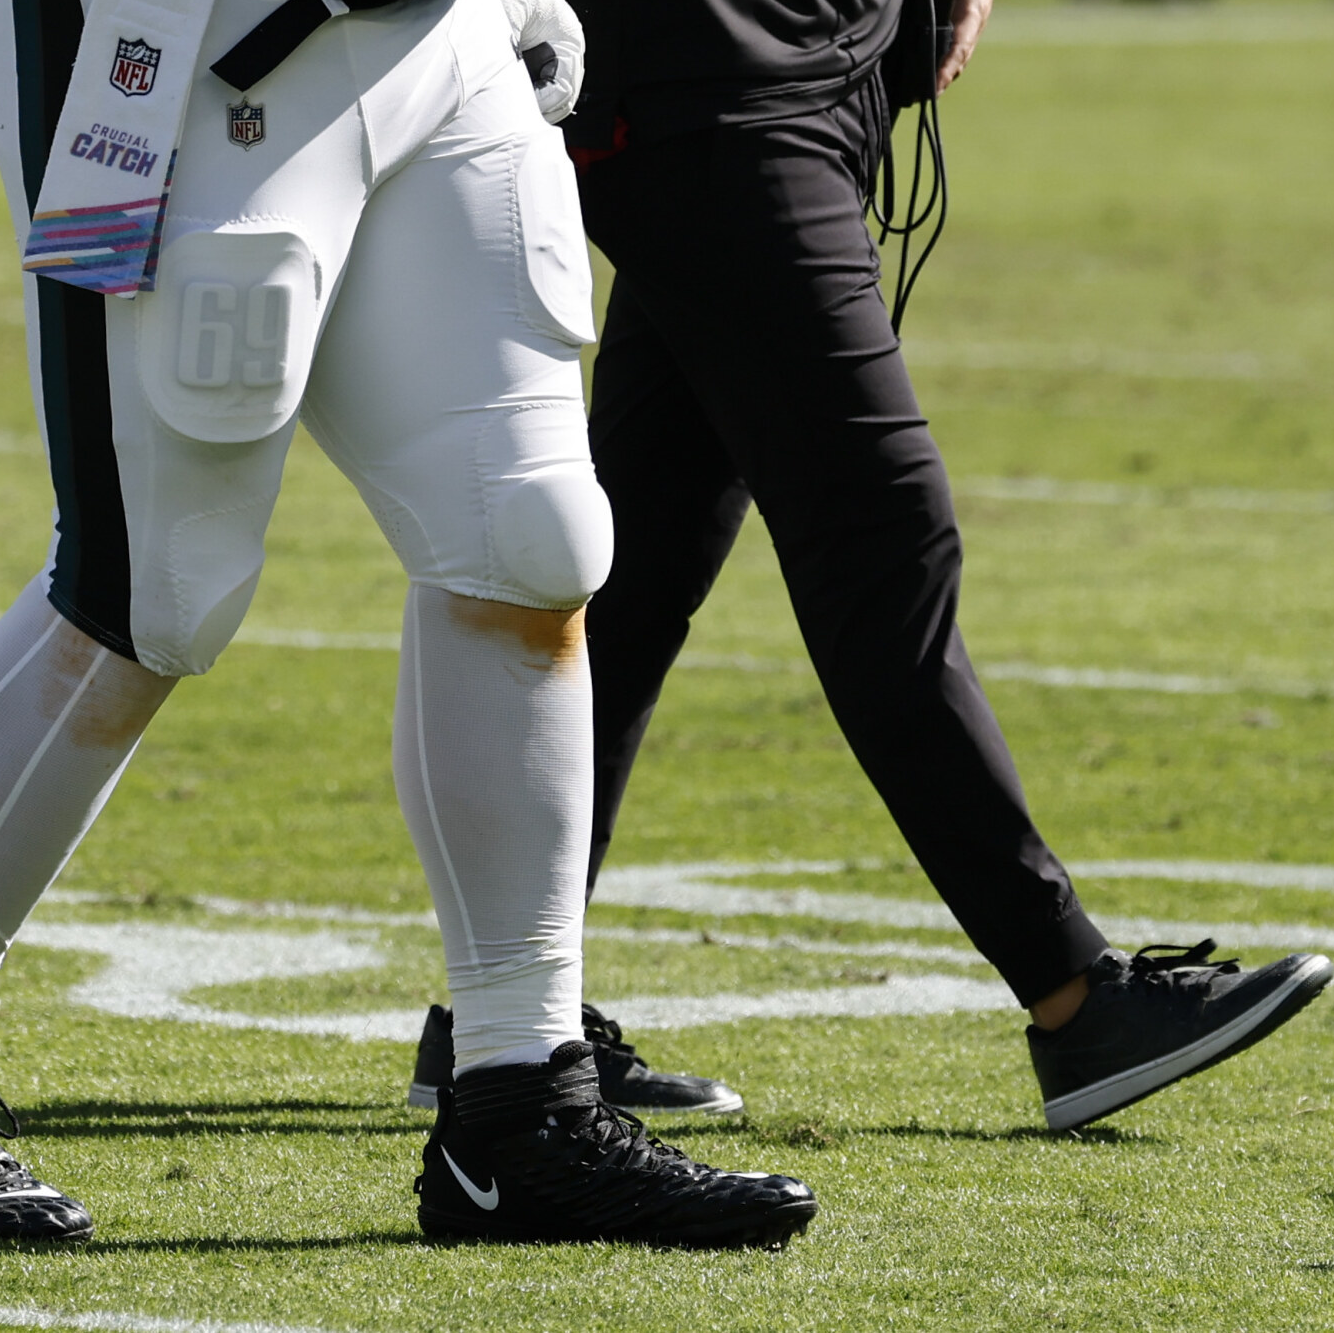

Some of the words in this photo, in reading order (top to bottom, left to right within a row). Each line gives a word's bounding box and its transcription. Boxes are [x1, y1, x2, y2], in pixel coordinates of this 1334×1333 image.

[114, 59, 149, 91] NFL
[90, 123, 149, 149] CRUCIAL
[234, 121, 261, 141] NFL
[70, 133, 158, 178] CATCH
[178, 281, 292, 387] 69
